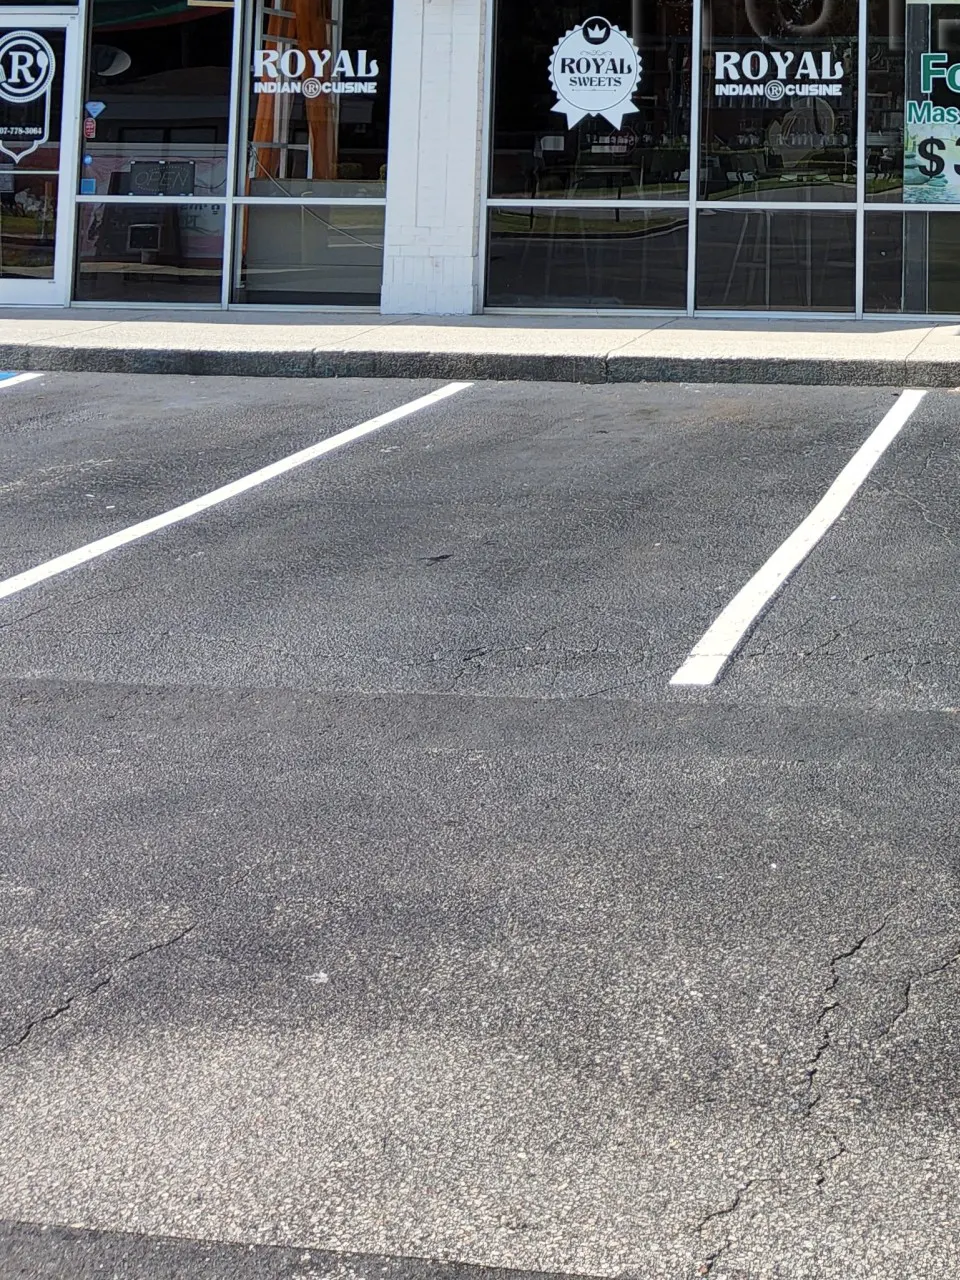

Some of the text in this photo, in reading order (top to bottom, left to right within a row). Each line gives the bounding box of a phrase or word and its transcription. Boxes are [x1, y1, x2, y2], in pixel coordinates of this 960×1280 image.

[253, 49, 379, 78] ROYAL
[560, 57, 633, 75] ROYAL
[715, 50, 844, 80] ROYAL
[254, 82, 301, 94] INDIAN
[321, 81, 377, 94] CUISINE
[569, 76, 622, 87] SWEETS
[715, 83, 764, 96] INDIAN
[785, 83, 842, 96] CUISINE
[135, 171, 190, 186] OPEN
